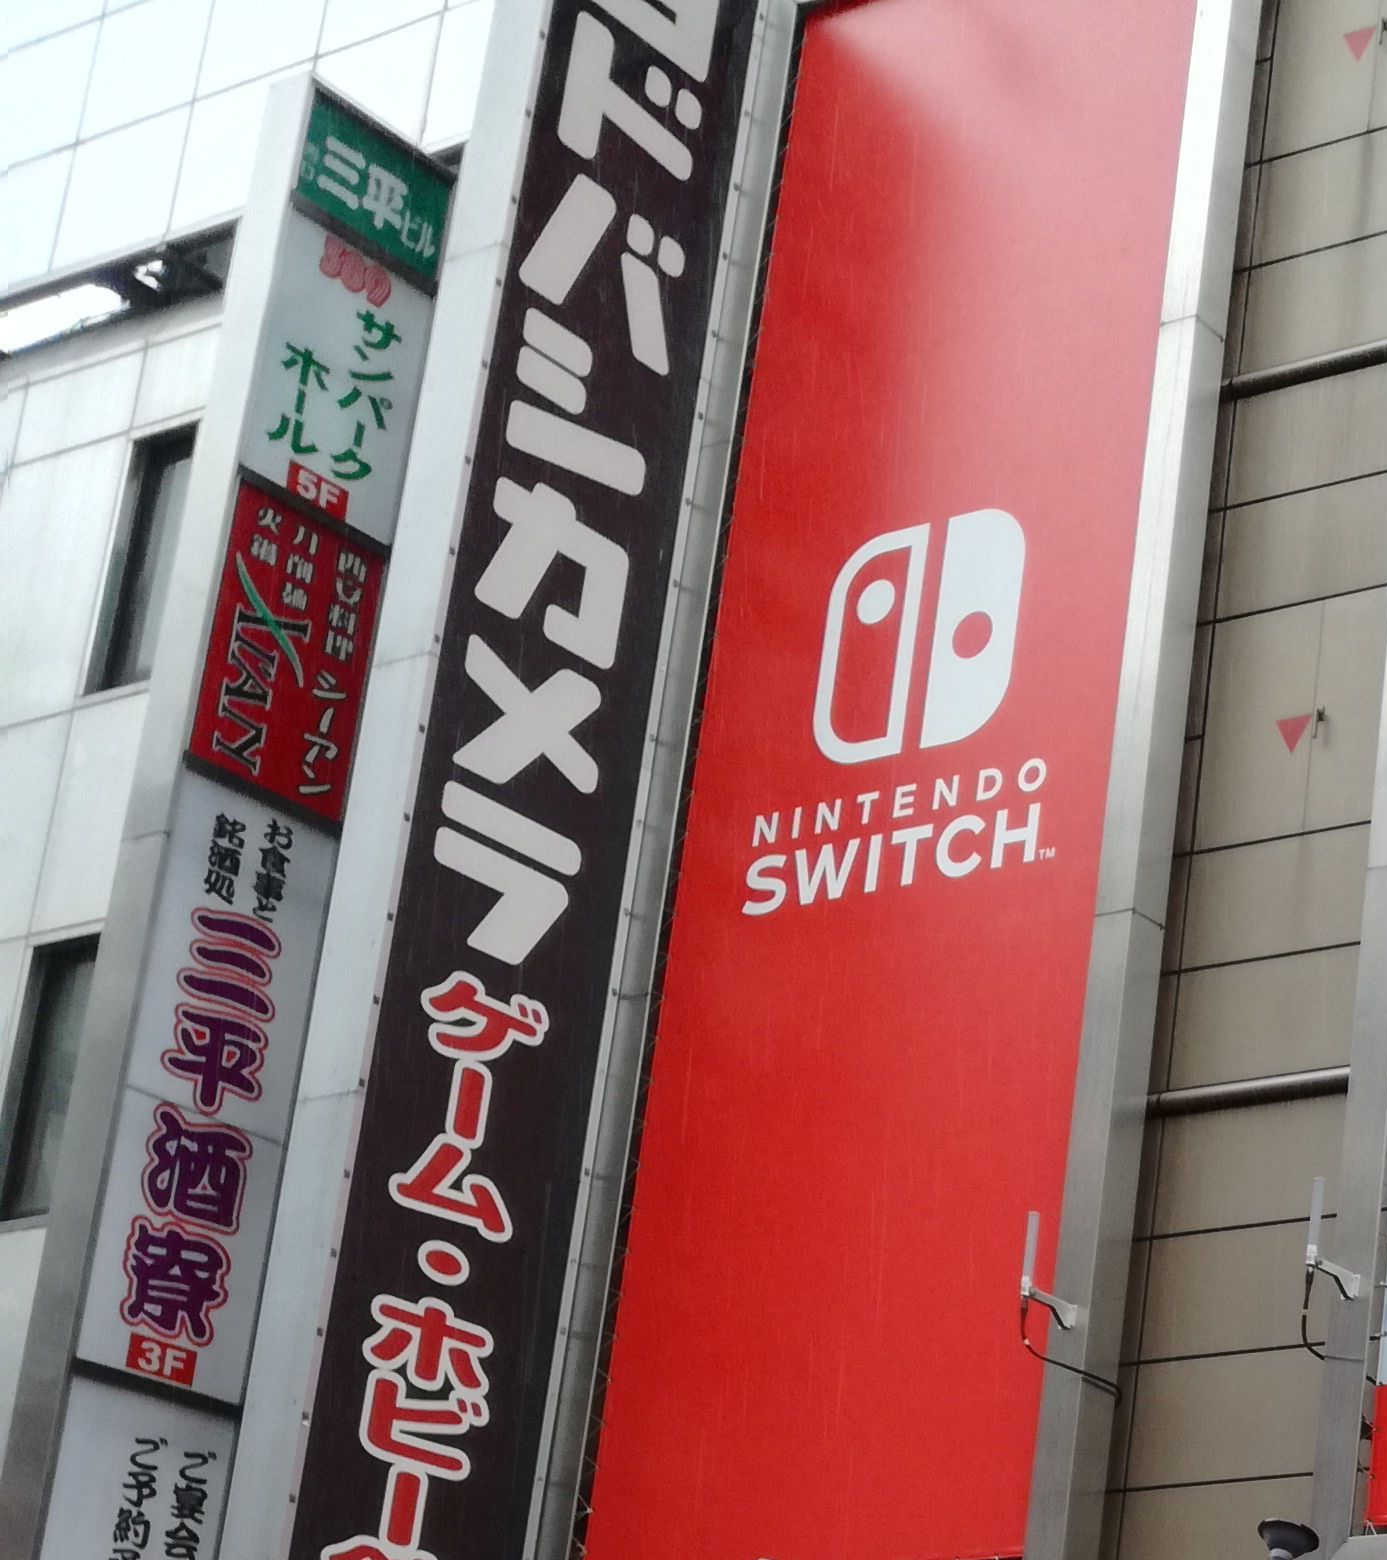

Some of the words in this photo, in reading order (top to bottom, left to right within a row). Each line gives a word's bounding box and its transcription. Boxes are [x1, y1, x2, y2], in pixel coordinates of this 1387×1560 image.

[317, 135, 436, 258] 三平ビル
[267, 342, 332, 454] ホール
[338, 310, 401, 480] サンパーク
[296, 471, 341, 508] 5F
[752, 758, 1047, 847] NINTENDO
[742, 803, 1041, 916] SWITCH
[137, 1340, 187, 1378] 3F
